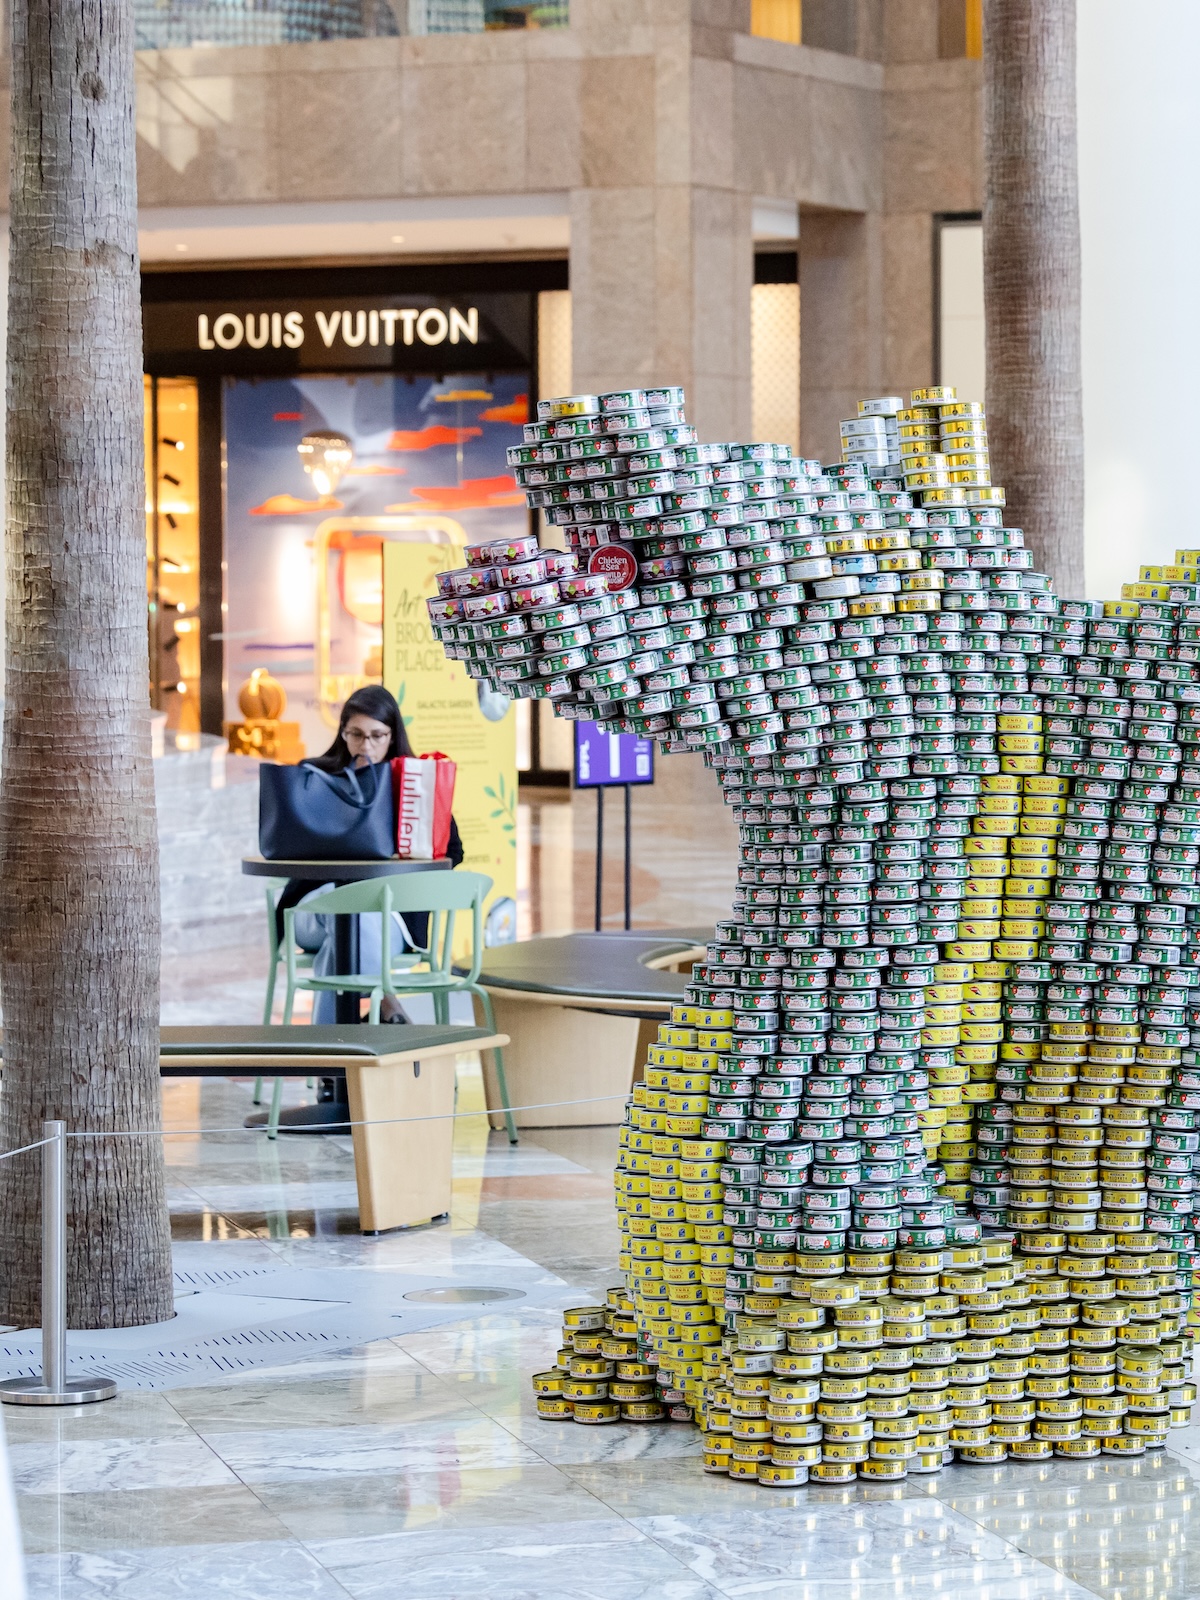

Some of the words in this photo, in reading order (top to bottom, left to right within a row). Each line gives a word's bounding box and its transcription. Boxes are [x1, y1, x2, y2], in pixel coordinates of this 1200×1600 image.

[199, 313, 304, 350] LOUIS
[315, 307, 478, 348] VUITTON
[598, 556, 627, 565] Chicken
[606, 563, 620, 571] Sea
[396, 649, 443, 672] PLACE
